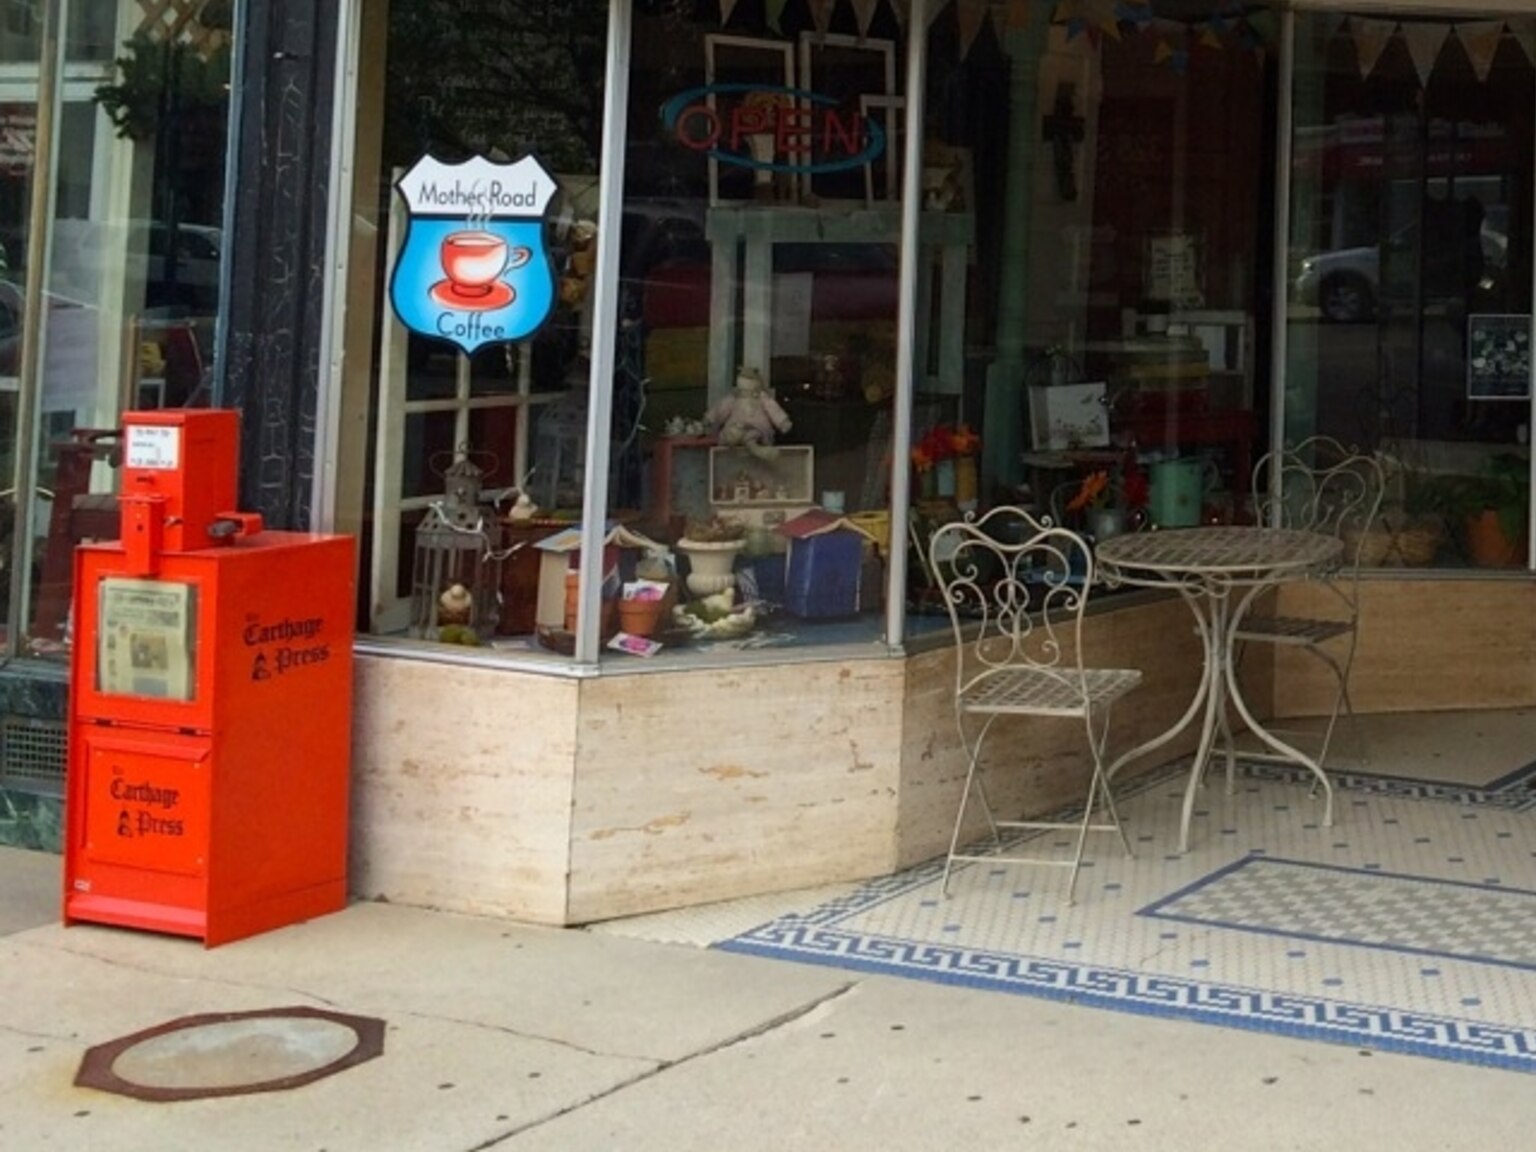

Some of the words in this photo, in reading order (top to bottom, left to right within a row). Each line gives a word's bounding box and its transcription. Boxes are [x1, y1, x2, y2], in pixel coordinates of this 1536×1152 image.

[676, 104, 860, 154] OPEN
[418, 181, 482, 206] Mother
[489, 181, 538, 207] Road
[436, 312, 506, 340] Coffee
[243, 618, 325, 646] Carthage
[274, 643, 330, 675] Press
[110, 777, 180, 809] Carthage
[137, 809, 184, 837] Press
